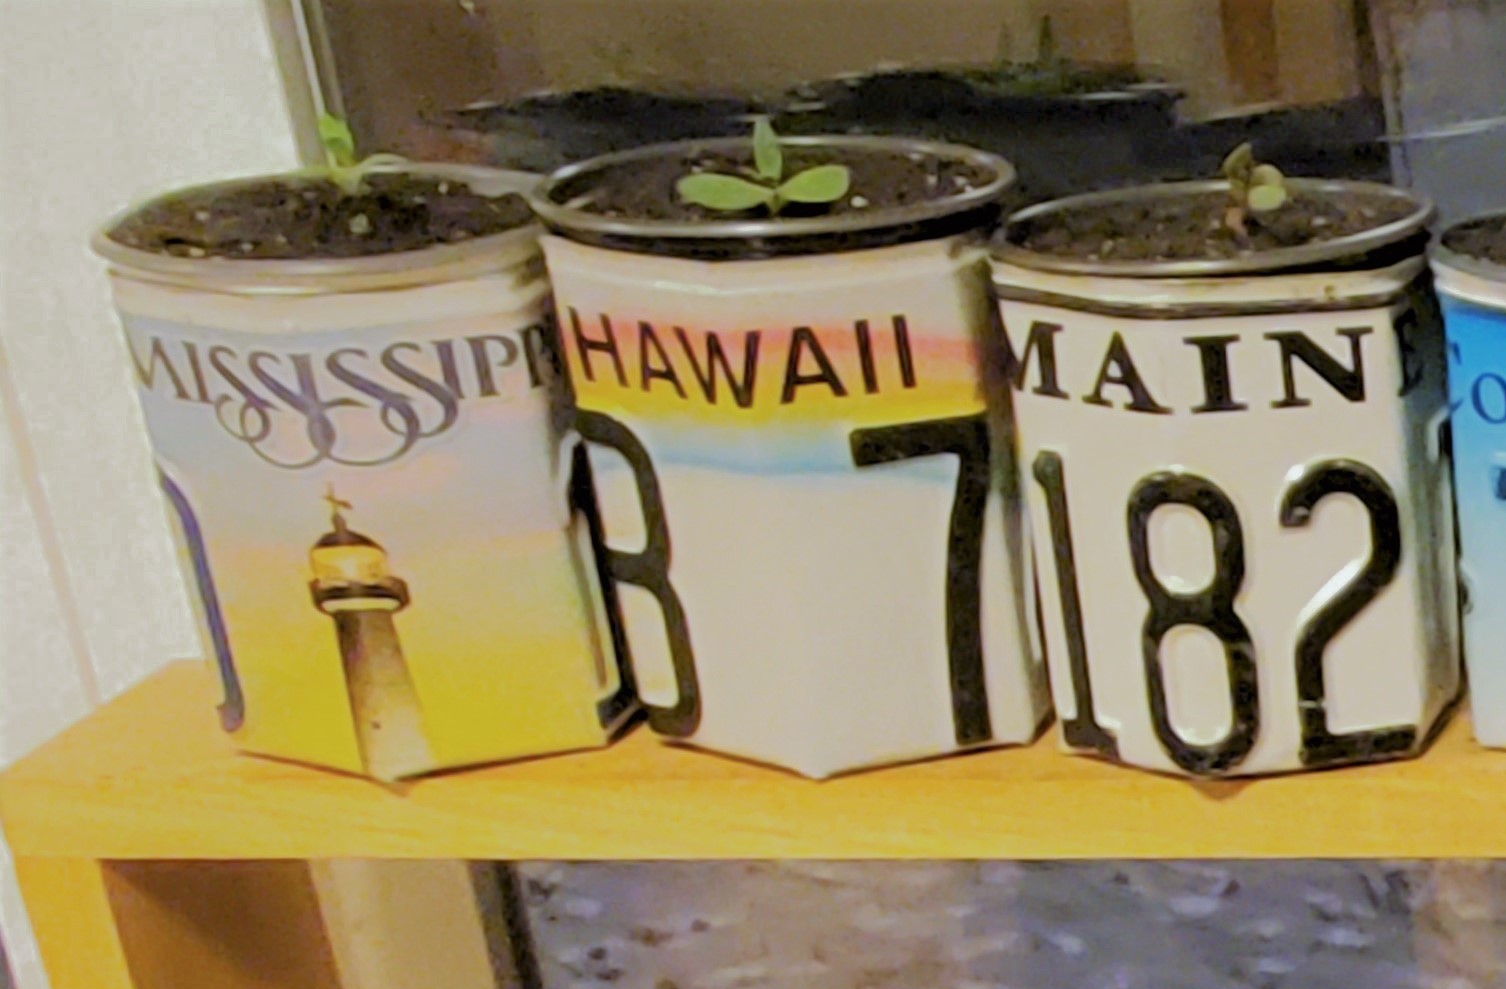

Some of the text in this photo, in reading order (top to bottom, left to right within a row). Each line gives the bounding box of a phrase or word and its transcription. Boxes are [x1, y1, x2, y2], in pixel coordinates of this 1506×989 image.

[567, 305, 918, 409] HAWAII
[850, 411, 994, 746] 7
[1032, 455, 1421, 777] 182
